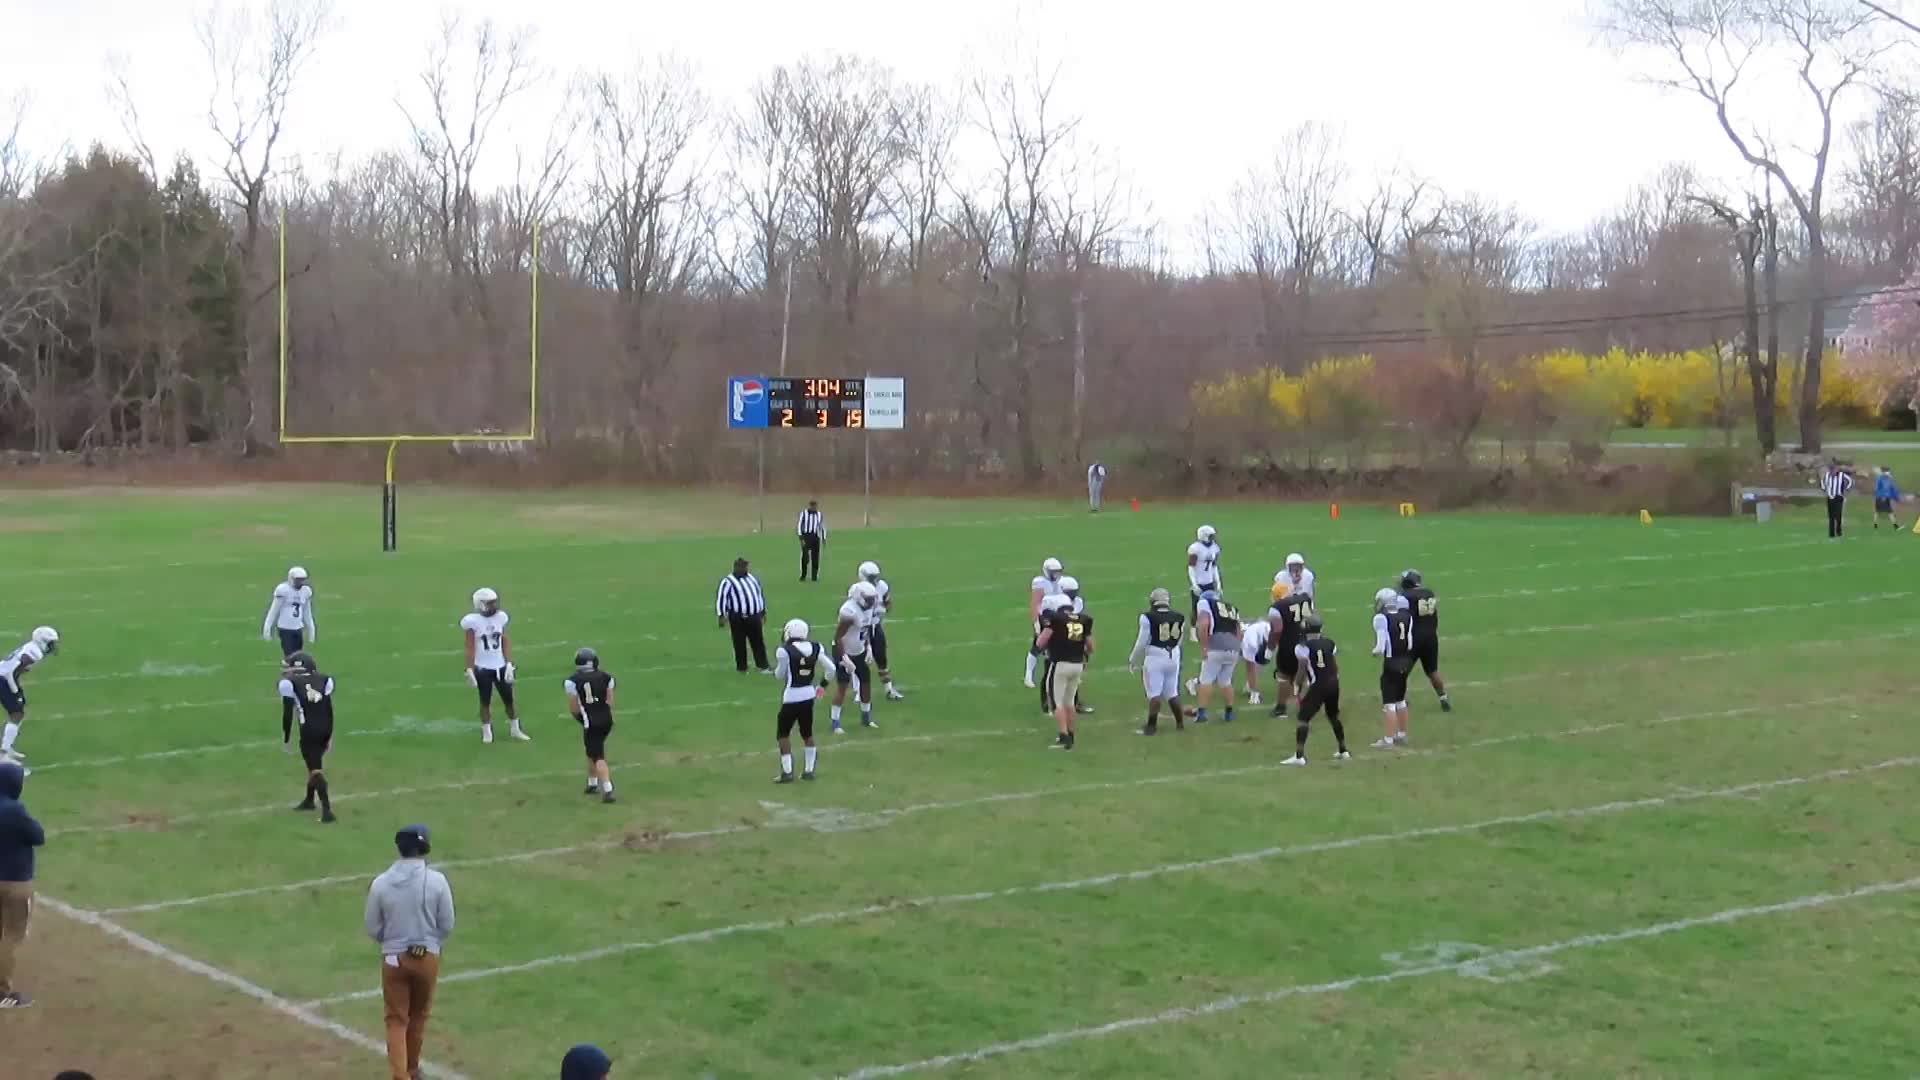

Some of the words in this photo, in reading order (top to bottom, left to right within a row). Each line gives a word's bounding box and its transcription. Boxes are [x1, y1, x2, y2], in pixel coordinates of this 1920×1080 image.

[781, 408, 793, 427] 2
[816, 408, 828, 427] 3
[291, 602, 301, 618] 3
[1397, 621, 1406, 640] 1
[480, 632, 503, 651] 13
[1316, 649, 1326, 668] 1
